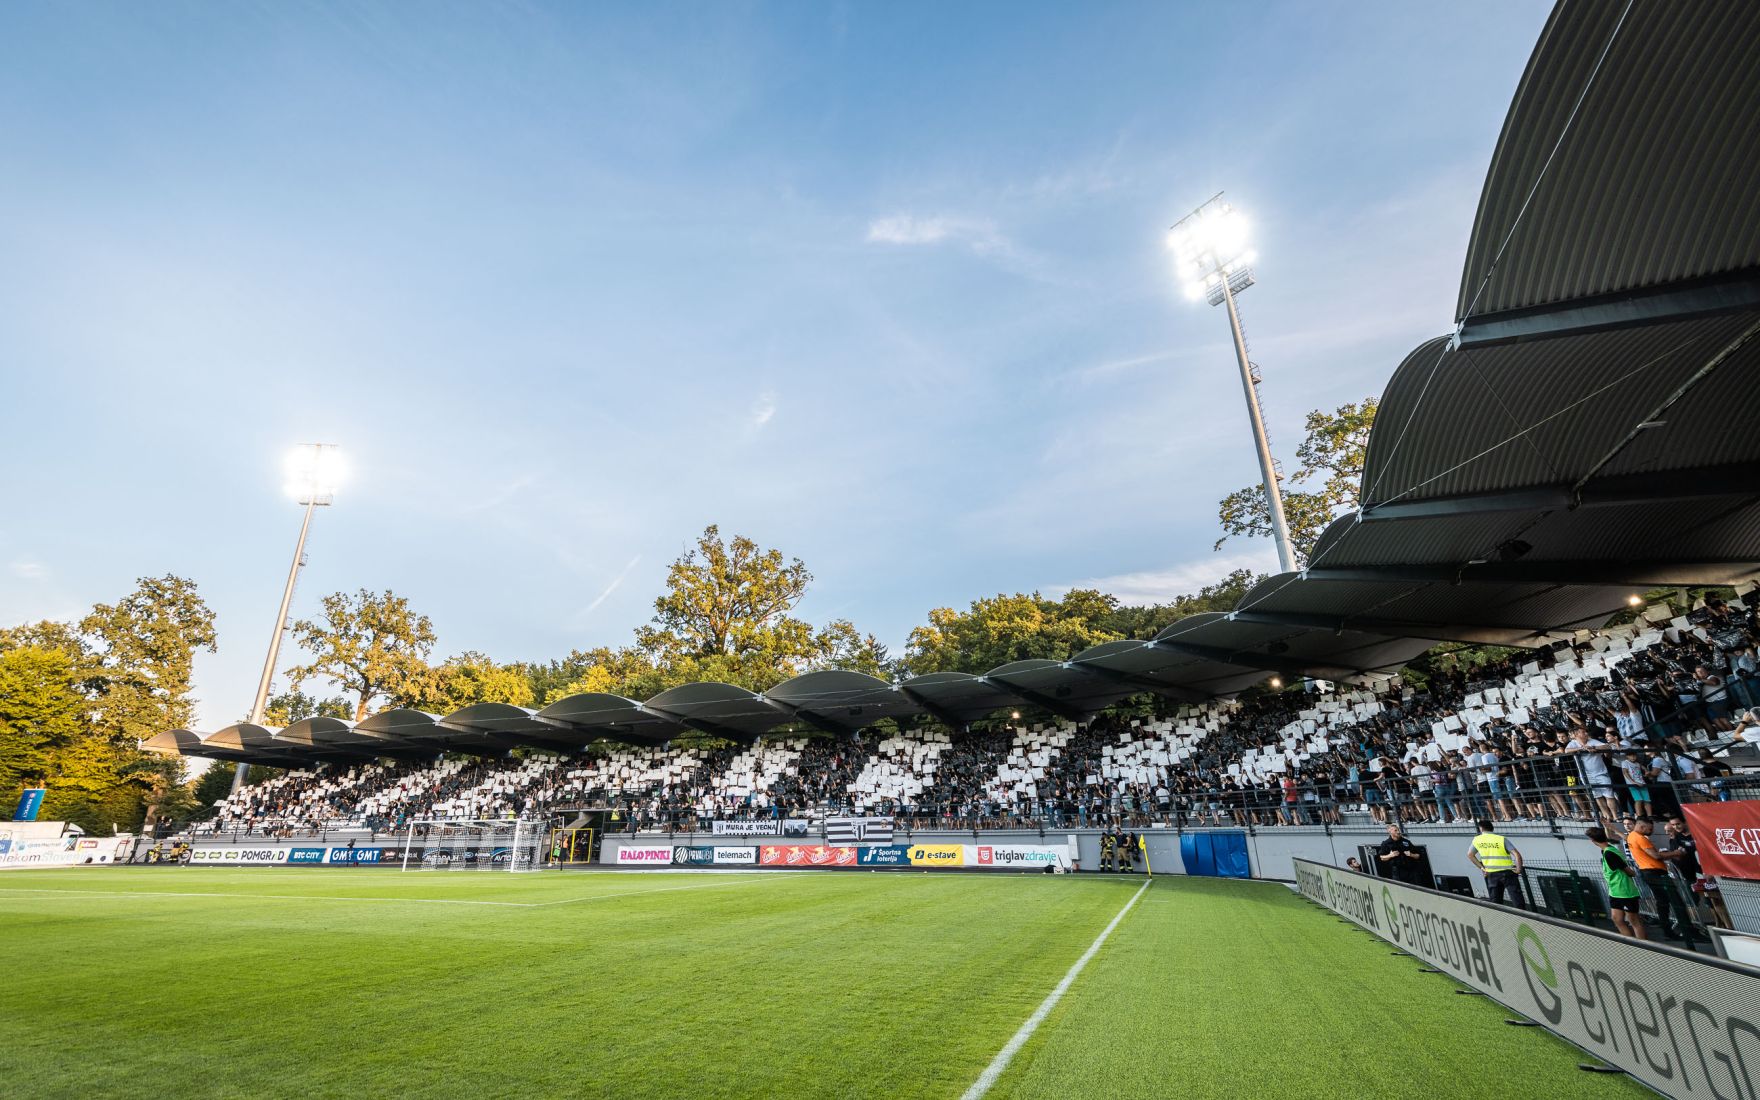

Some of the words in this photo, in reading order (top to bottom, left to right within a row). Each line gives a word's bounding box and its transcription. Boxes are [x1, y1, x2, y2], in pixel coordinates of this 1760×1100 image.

[357, 851, 380, 861] GMT
[620, 850, 644, 860] HALO
[645, 850, 671, 860] PINKI
[718, 851, 752, 859] telemach
[878, 848, 902, 857] Športna
[927, 850, 957, 859] e-stave
[1335, 880, 1380, 931] energovat
[1400, 903, 1504, 994] energovat
